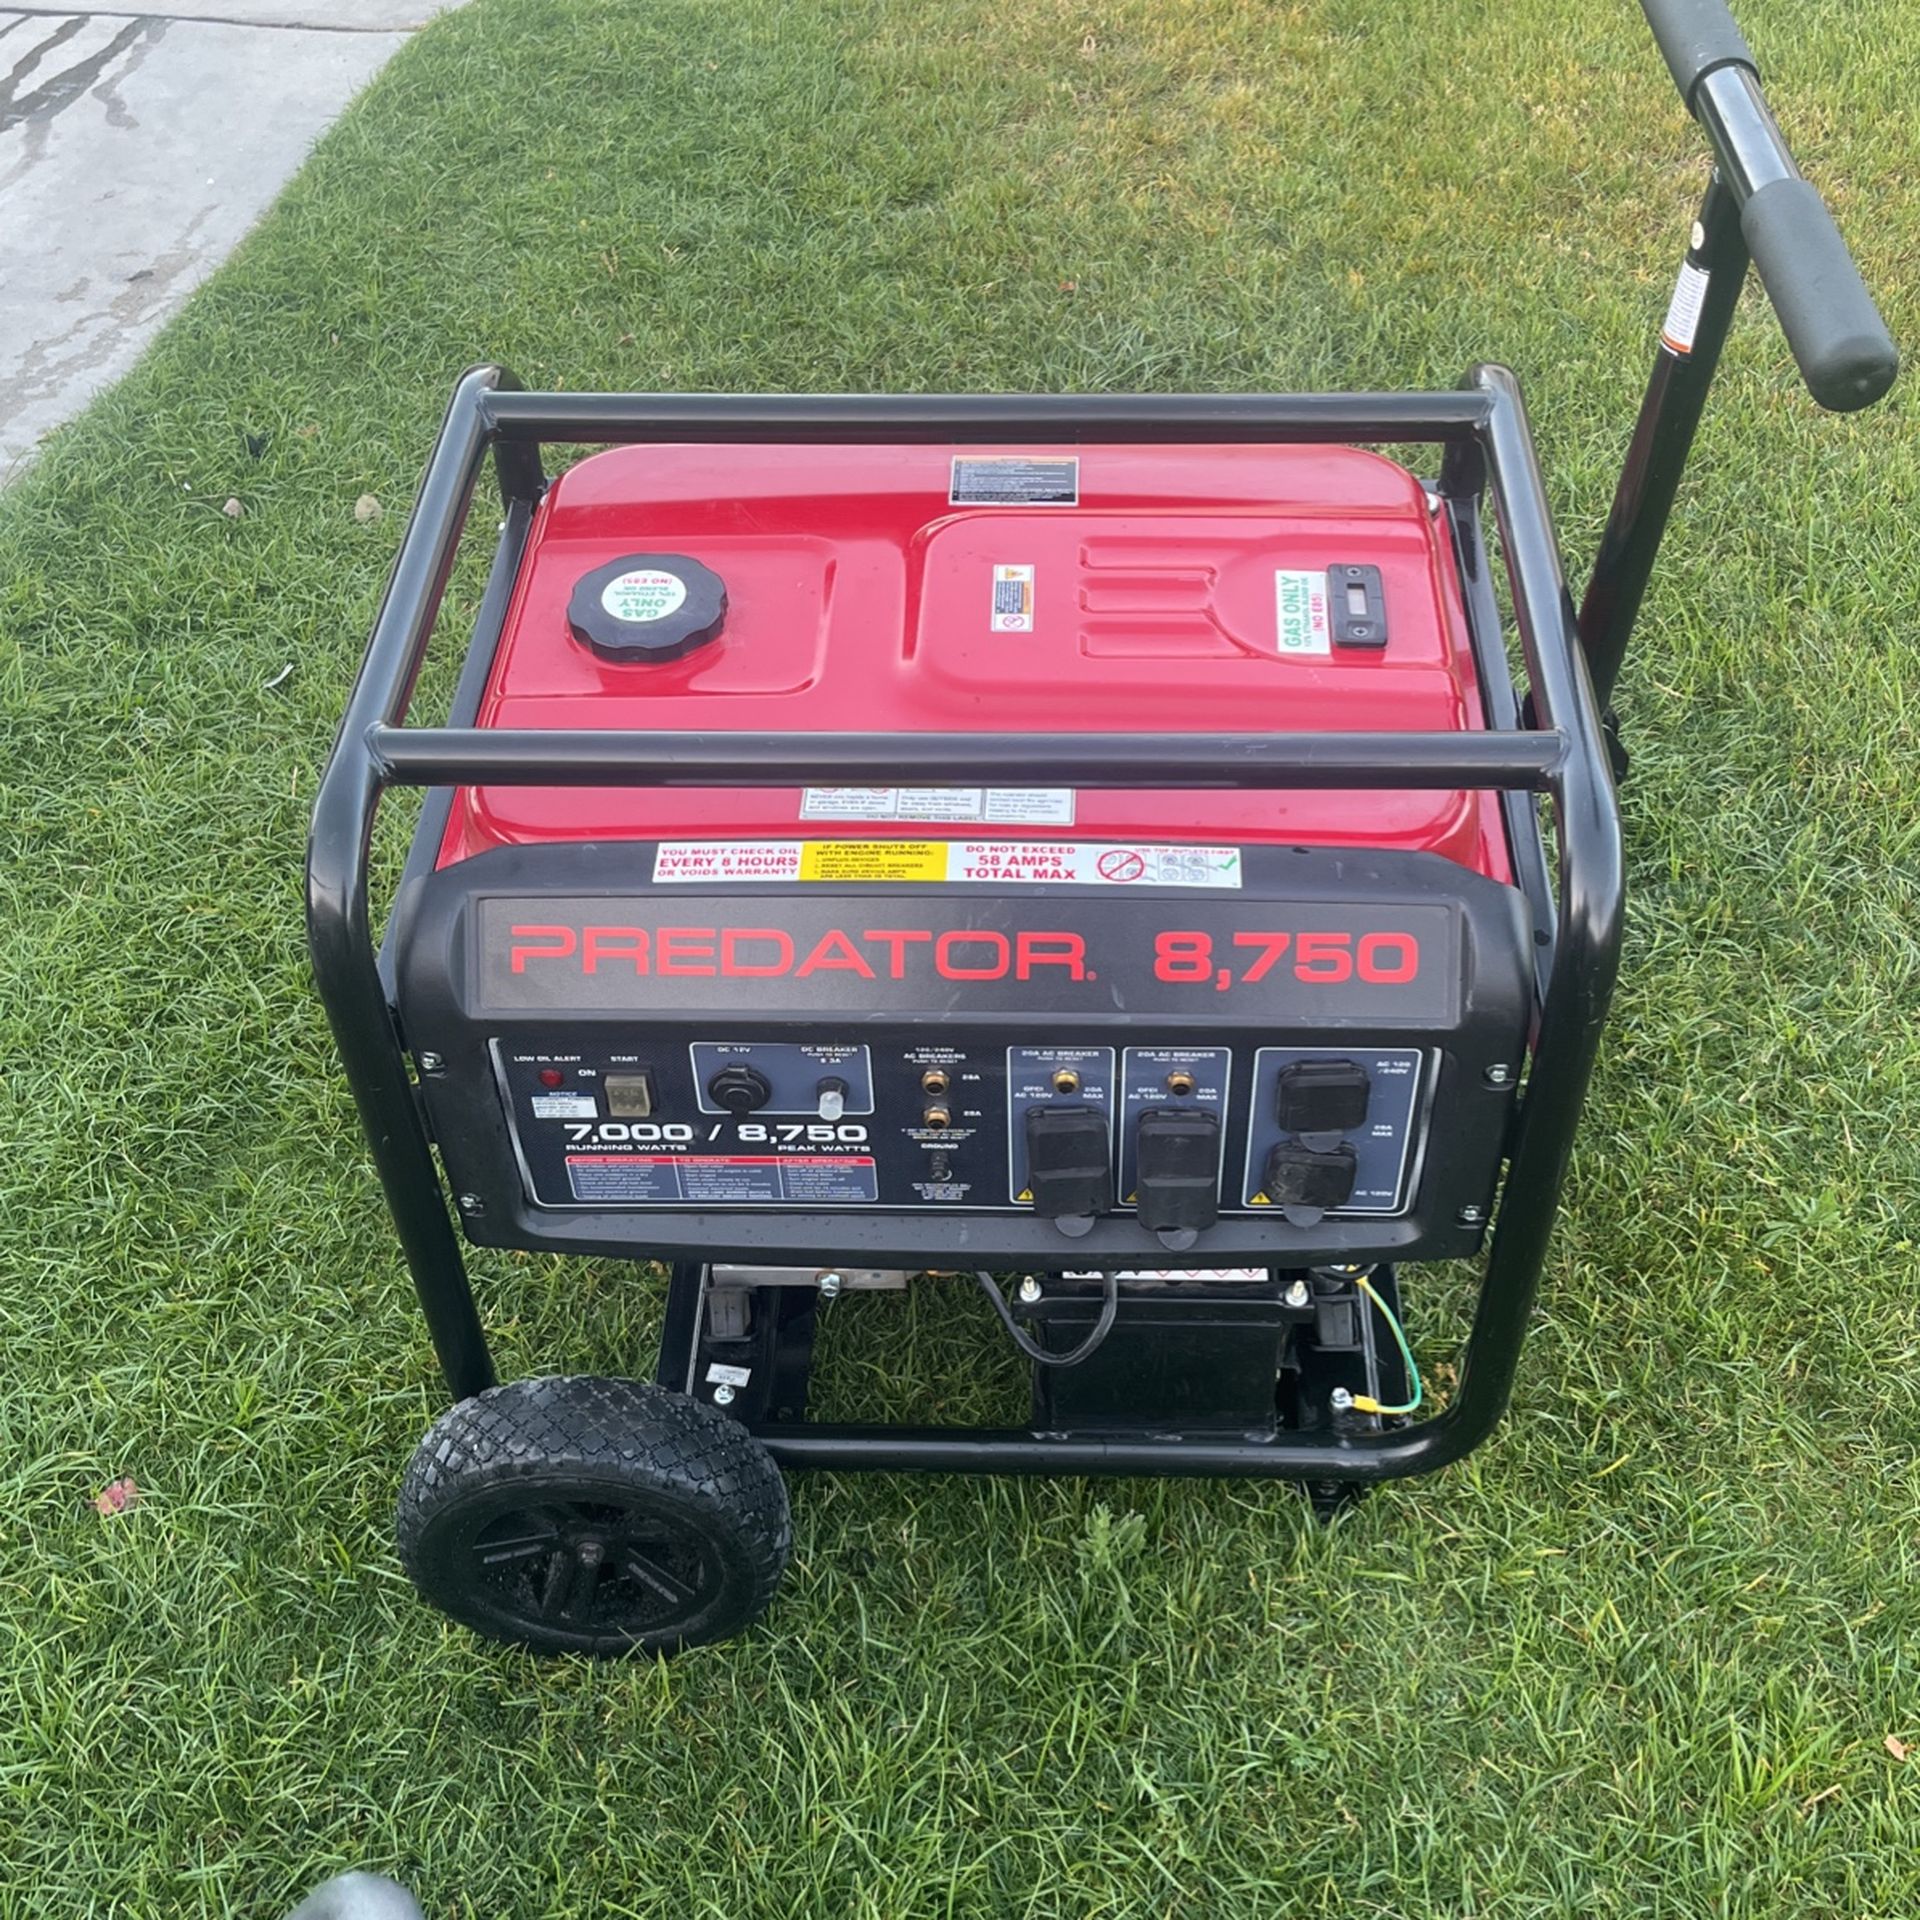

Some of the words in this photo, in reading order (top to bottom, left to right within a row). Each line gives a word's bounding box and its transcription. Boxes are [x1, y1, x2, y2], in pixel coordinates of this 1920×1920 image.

[1281, 576, 1300, 613] ONLY
[619, 598, 667, 608] ONLY
[1311, 593, 1323, 613] E85)
[622, 608, 659, 618] GAS
[1312, 615, 1324, 632] (NO
[1283, 618, 1302, 647] GAS
[663, 847, 687, 856] YOU
[691, 847, 726, 856] MUST
[731, 847, 775, 856] CHECK
[779, 847, 799, 855] OIL
[1022, 846, 1075, 854] EXCEED
[660, 857, 715, 867] EVERY
[722, 857, 731, 867] 8
[738, 856, 798, 866] HOURS
[978, 855, 1001, 866] 58
[1008, 855, 1062, 867] AMPS
[724, 868, 798, 876] WARRANTY
[964, 867, 1026, 879] TOTAL
[1032, 868, 1076, 880] MAX
[511, 925, 1087, 981] PREDATOR
[1154, 931, 1419, 990] 8,750
[577, 1069, 597, 1077] ON
[564, 1123, 693, 1144] 7,000
[708, 1123, 722, 1142] /
[737, 1124, 868, 1144] 8,750
